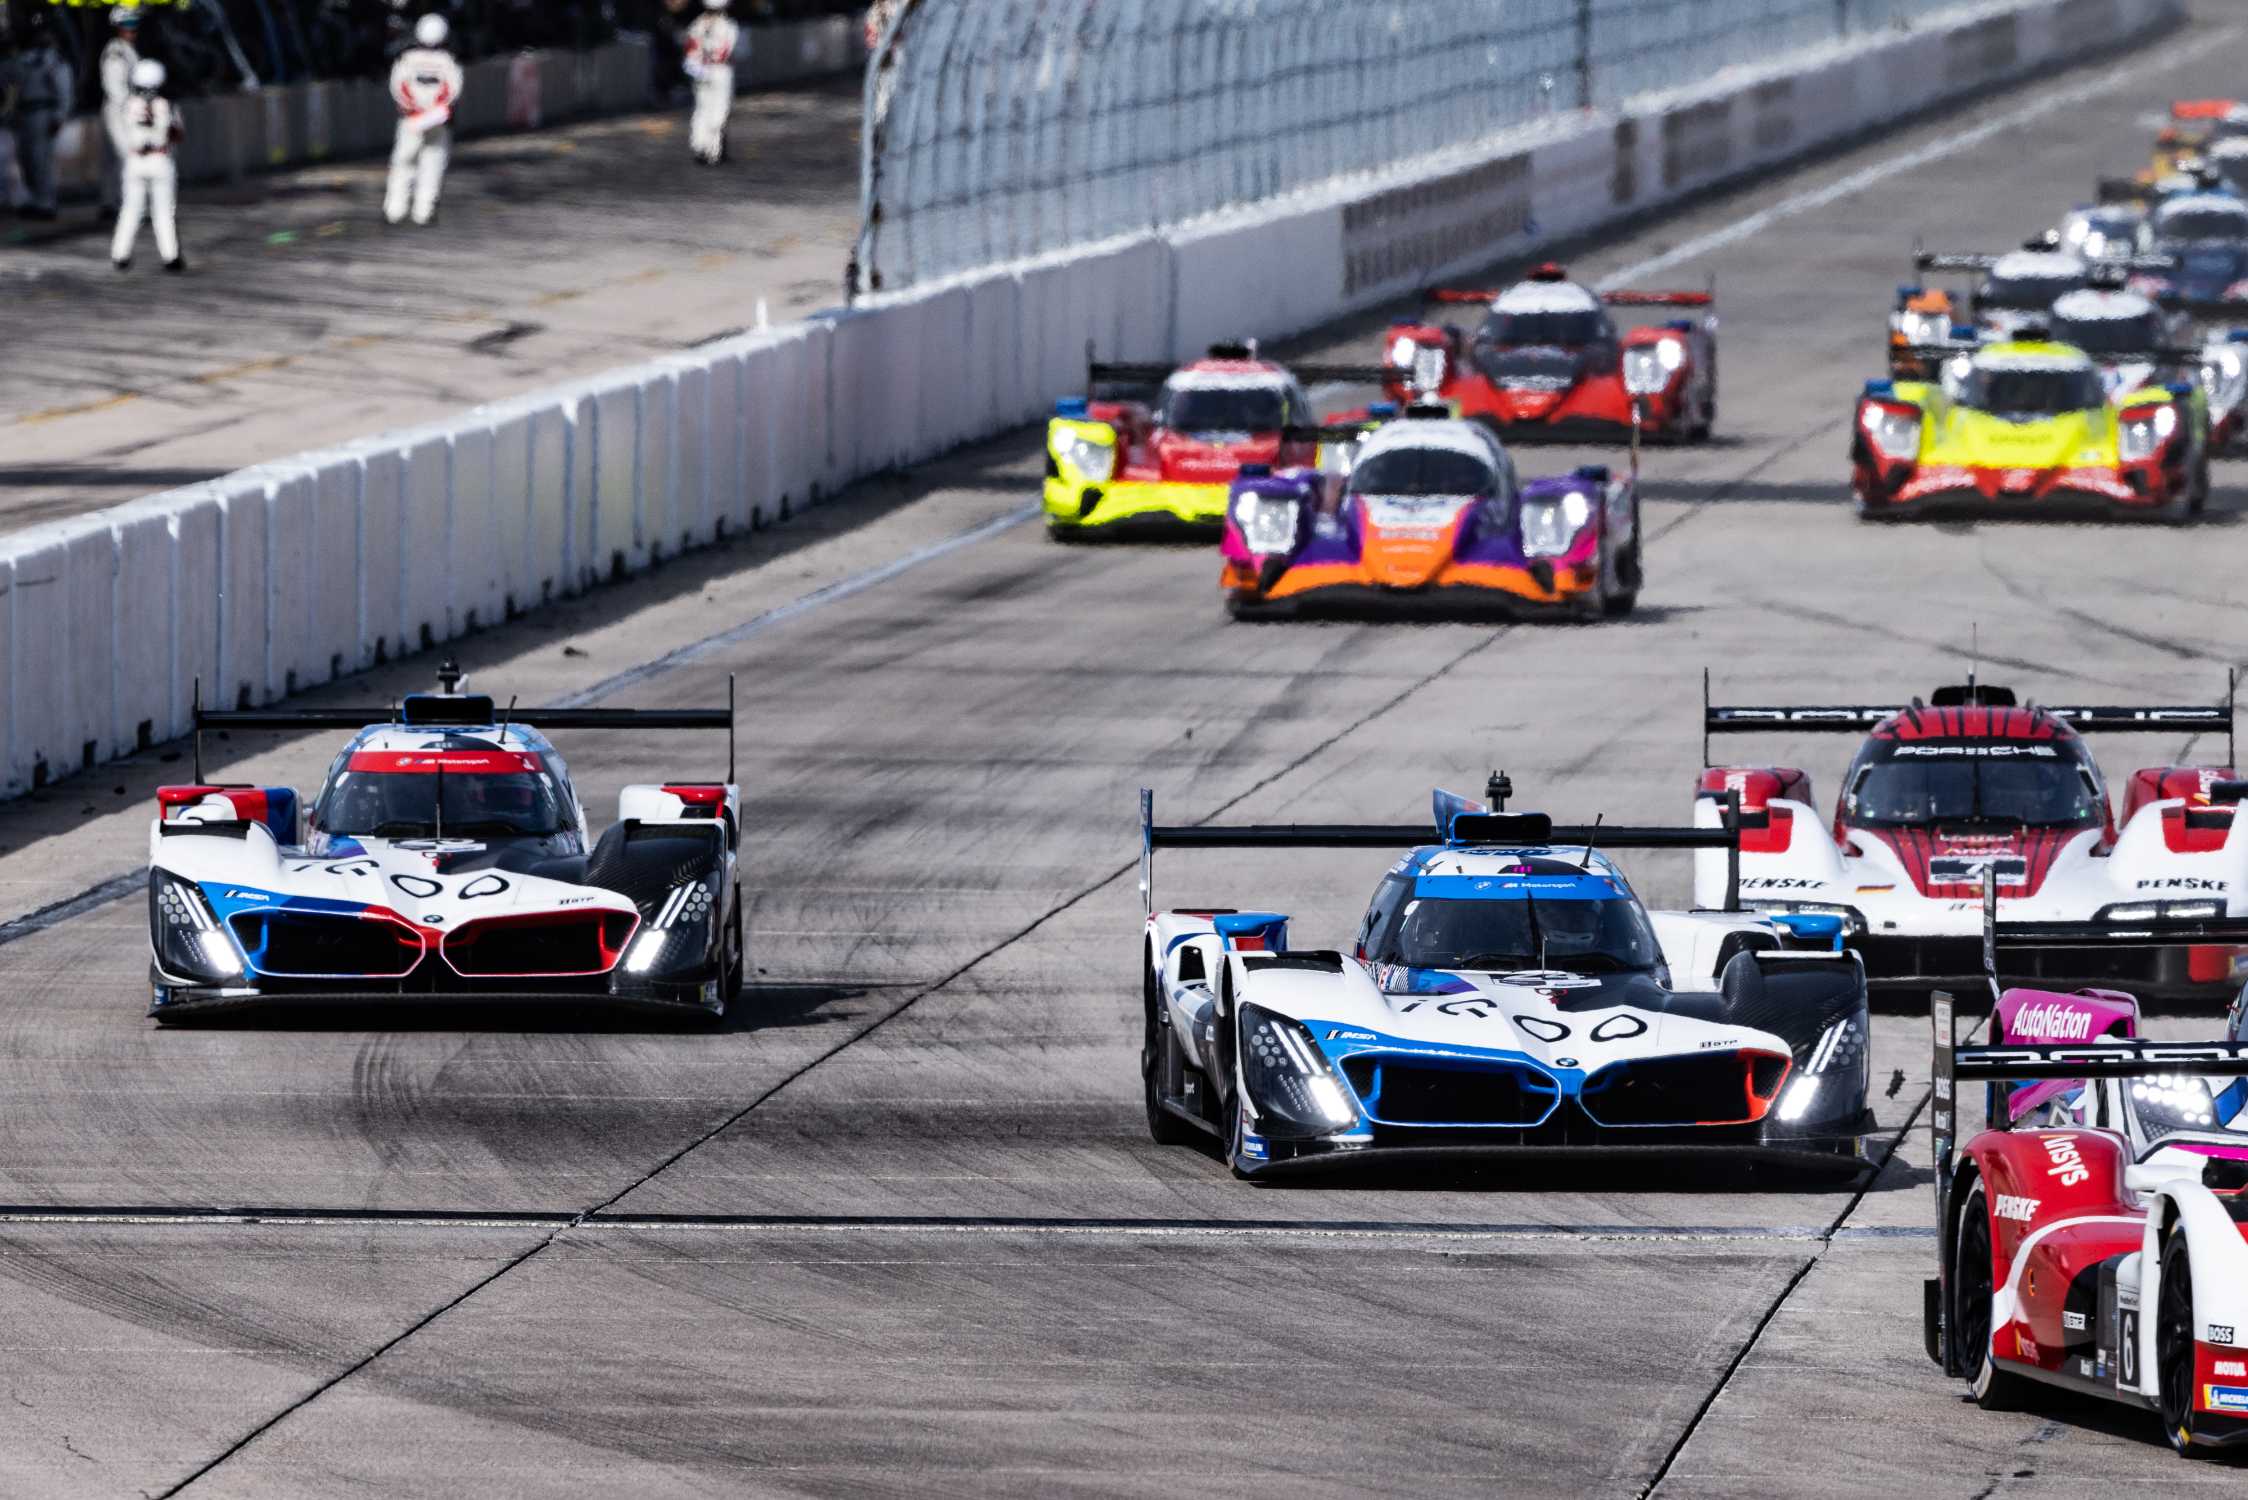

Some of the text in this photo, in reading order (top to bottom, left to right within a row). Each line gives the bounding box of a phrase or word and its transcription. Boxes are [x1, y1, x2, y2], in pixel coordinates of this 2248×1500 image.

[1894, 745, 2058, 757] PORSCHE
[2136, 878, 2230, 891] PENSKE
[2010, 1002, 2093, 1040] AutoNation
[1340, 1030, 1377, 1041] IMSA
[1994, 1194, 2042, 1221] PENSKE
[2208, 1325, 2233, 1343] BOSS
[2123, 1313, 2135, 1381] 6
[2213, 1361, 2247, 1376] MOTUL
